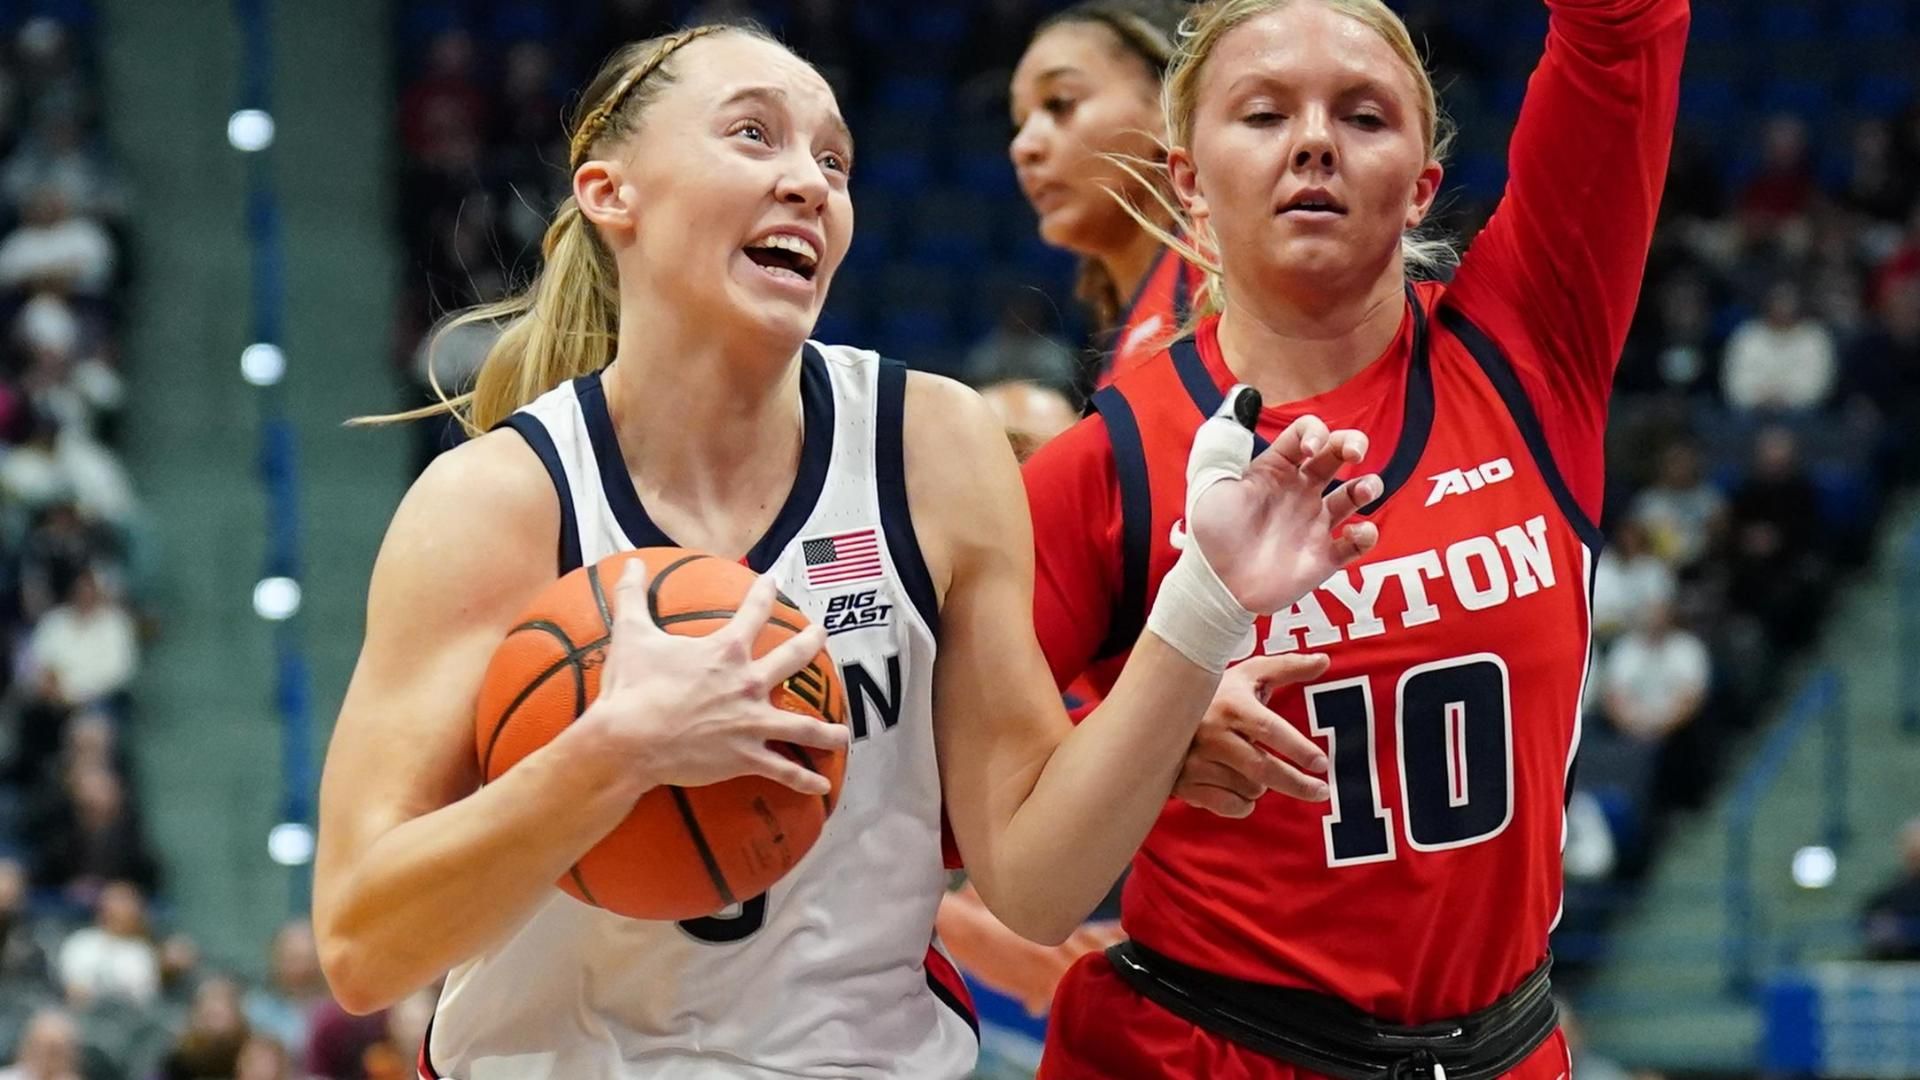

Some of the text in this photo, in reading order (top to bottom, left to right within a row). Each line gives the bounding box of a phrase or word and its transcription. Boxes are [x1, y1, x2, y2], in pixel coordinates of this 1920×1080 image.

[1425, 457, 1514, 507] A10
[826, 589, 878, 614] BIG
[1229, 514, 1557, 660] AYTON
[824, 604, 894, 630] EAST
[1304, 652, 1514, 868] 10
